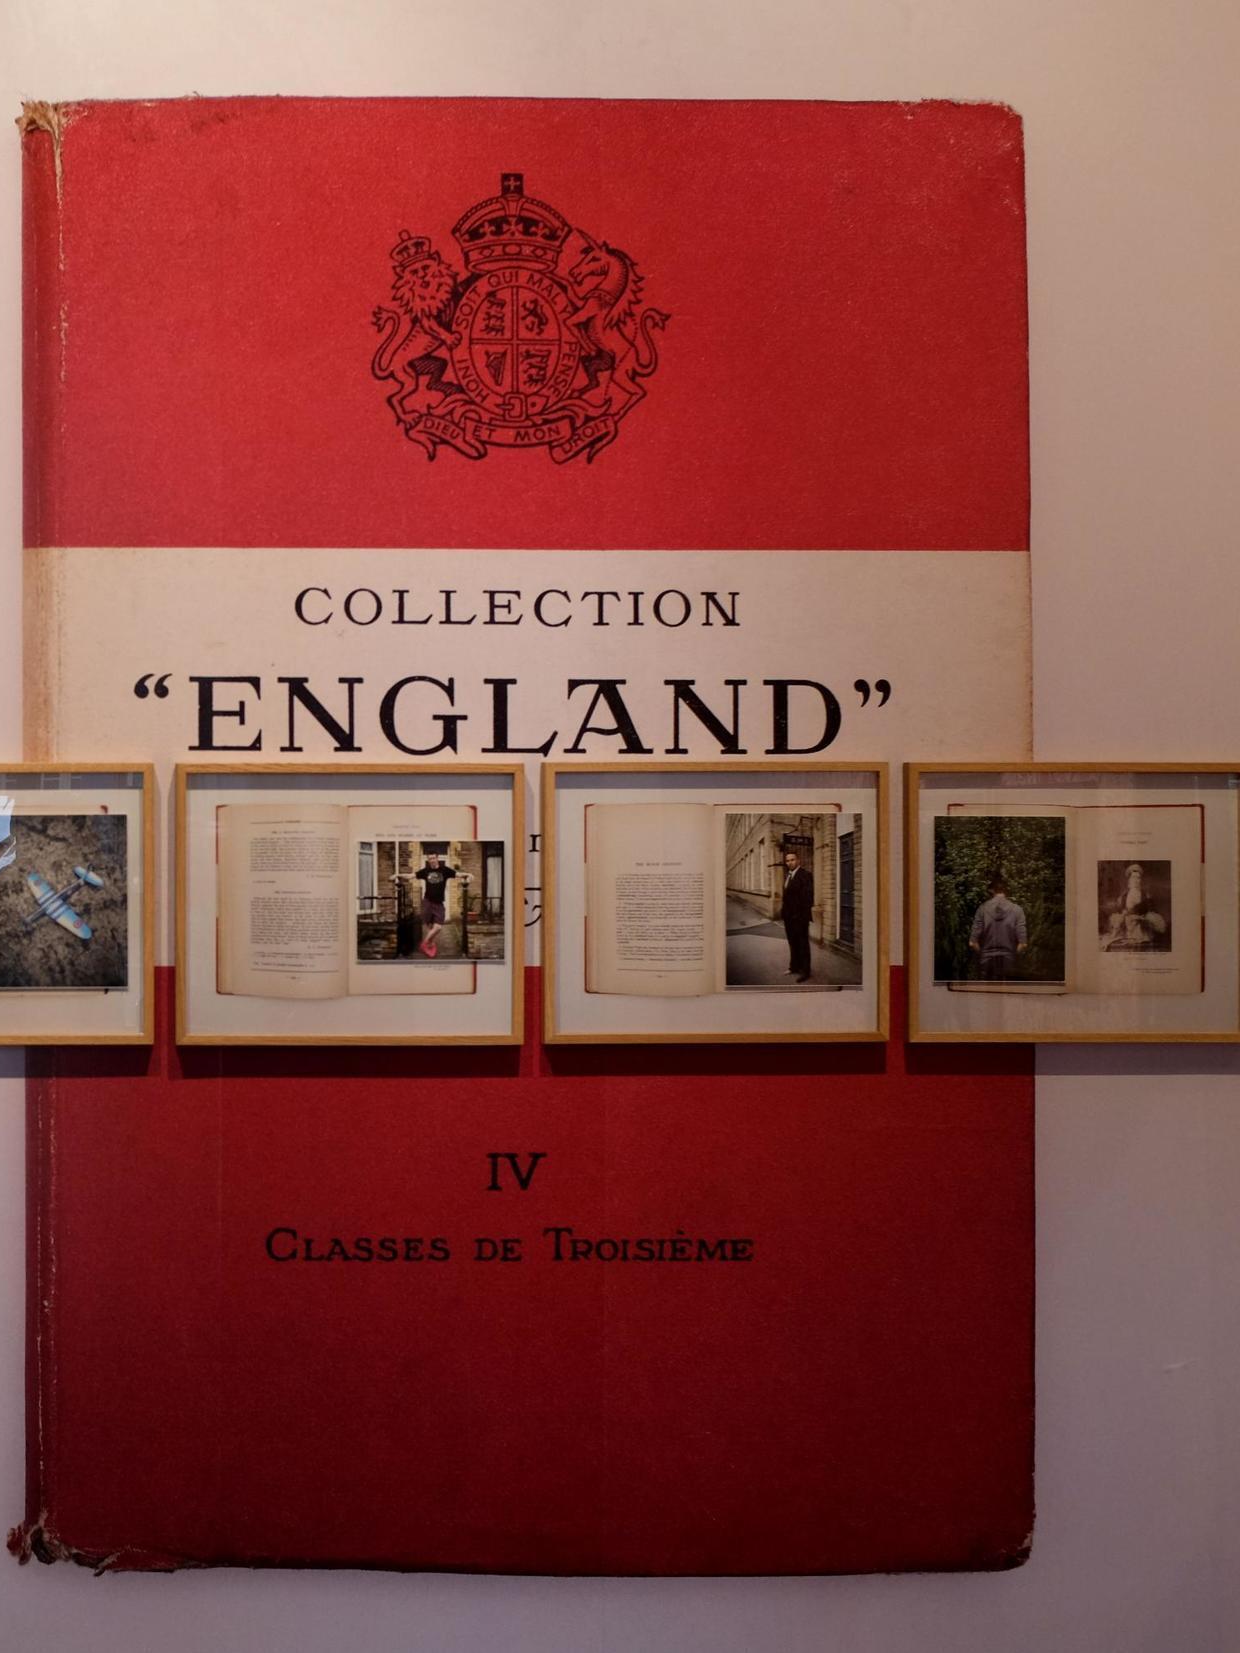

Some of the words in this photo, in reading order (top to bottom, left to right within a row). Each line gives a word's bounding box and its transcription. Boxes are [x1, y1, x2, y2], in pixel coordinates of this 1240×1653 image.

[487, 270, 520, 288] QUI
[455, 286, 482, 330] SOIT
[456, 358, 490, 404] HONI
[547, 341, 580, 398] PENSE
[423, 419, 460, 440] DIEU
[472, 424, 497, 440] ET
[513, 425, 561, 442] MON
[294, 587, 741, 628] COLLECTION
[133, 673, 892, 758] “ENGLAND”
[487, 1151, 547, 1192] IV
